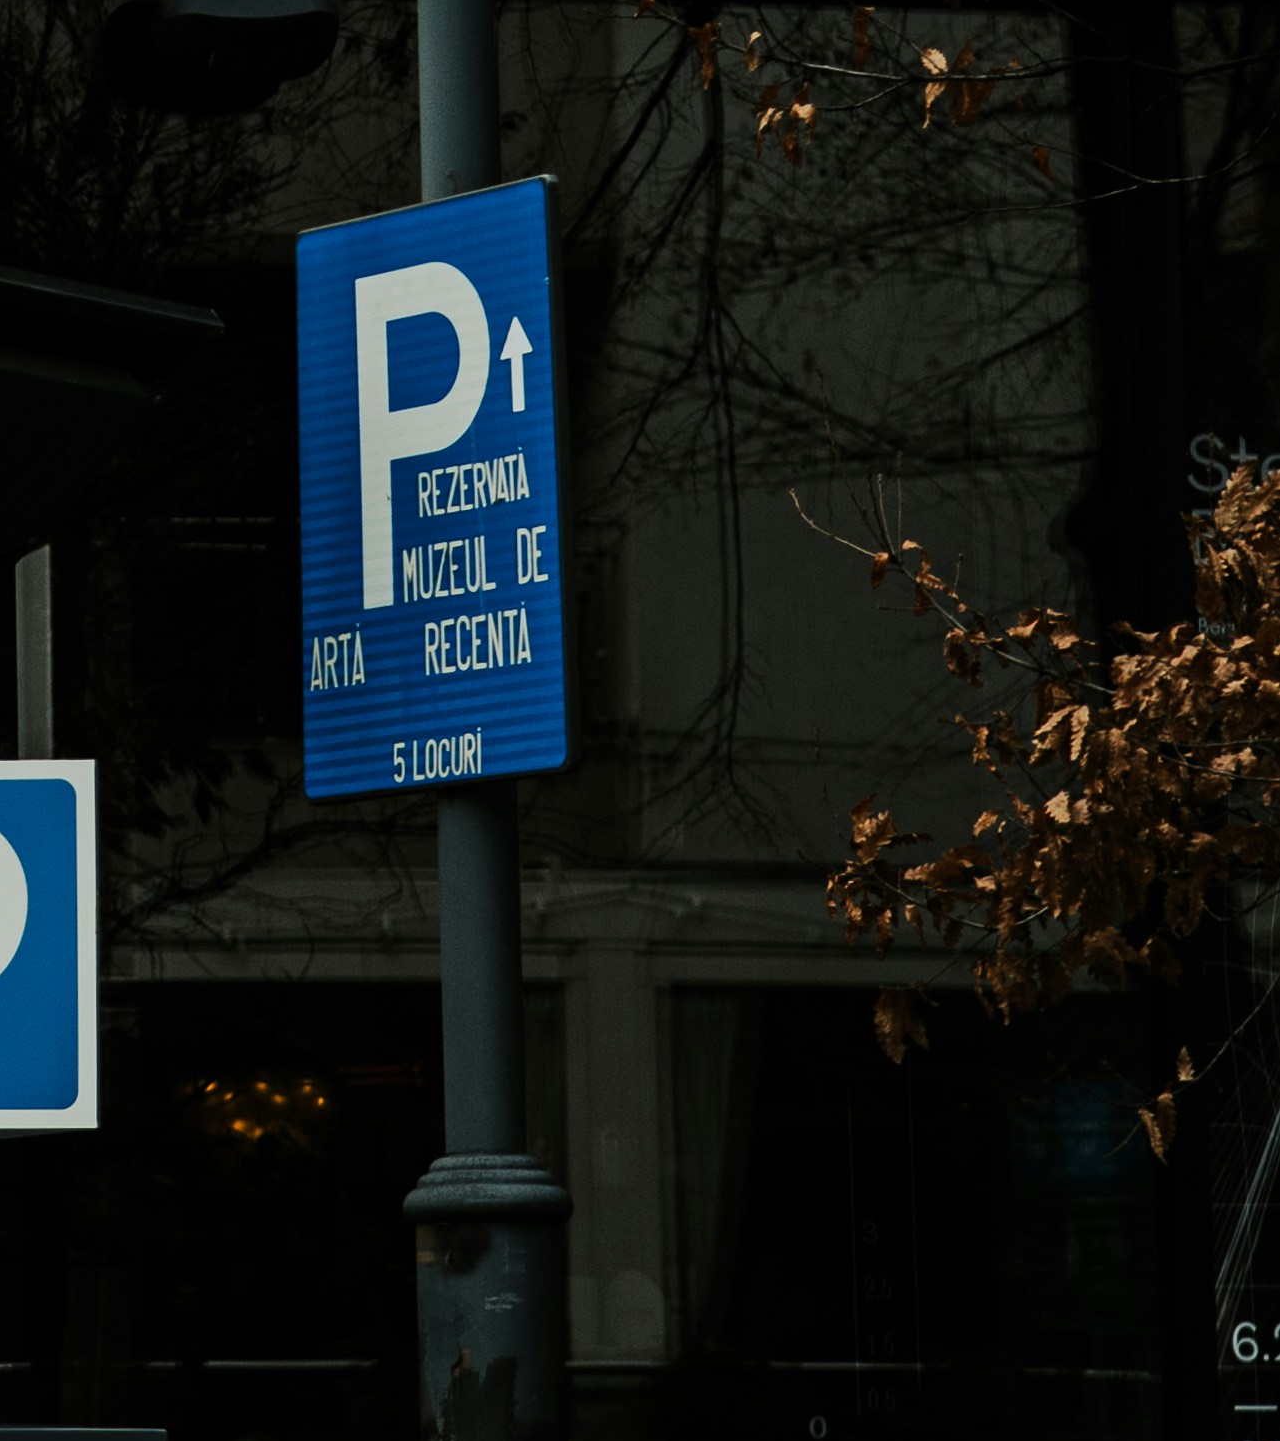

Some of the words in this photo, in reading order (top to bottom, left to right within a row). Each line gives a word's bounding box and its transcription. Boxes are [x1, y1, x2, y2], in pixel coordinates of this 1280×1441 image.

[355, 261, 491, 610] P
[402, 535, 497, 603] MUZEUL
[516, 525, 549, 585] DE
[393, 742, 406, 783] 5
